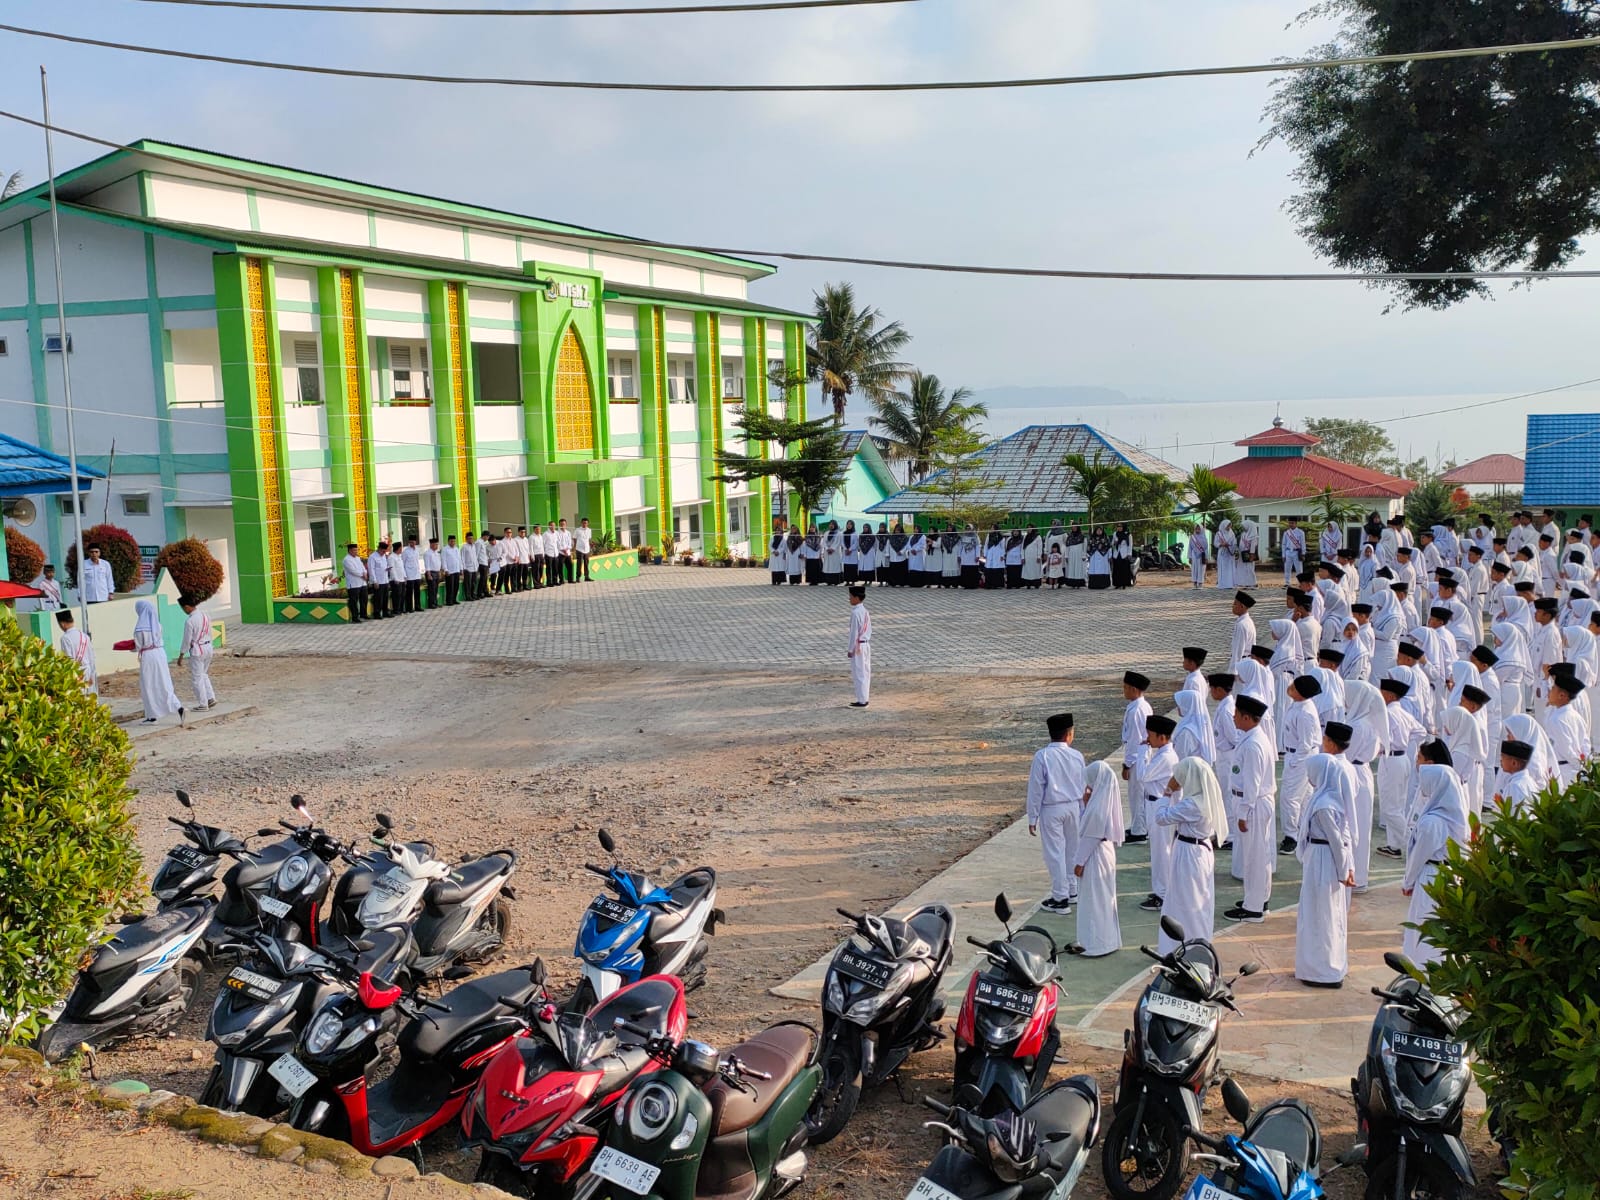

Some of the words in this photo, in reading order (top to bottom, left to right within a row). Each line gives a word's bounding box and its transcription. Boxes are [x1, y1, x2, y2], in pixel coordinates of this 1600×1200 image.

[856, 960, 877, 973] 3927
[980, 982, 992, 993] BH
[996, 987, 1019, 1000] 6864
[1413, 1037, 1440, 1050] 4189
[600, 1149, 614, 1162] BH
[615, 1156, 640, 1174] 6639
[641, 1169, 656, 1181] AE
[917, 1181, 933, 1196] BH
[1204, 1189, 1220, 1200] BH
